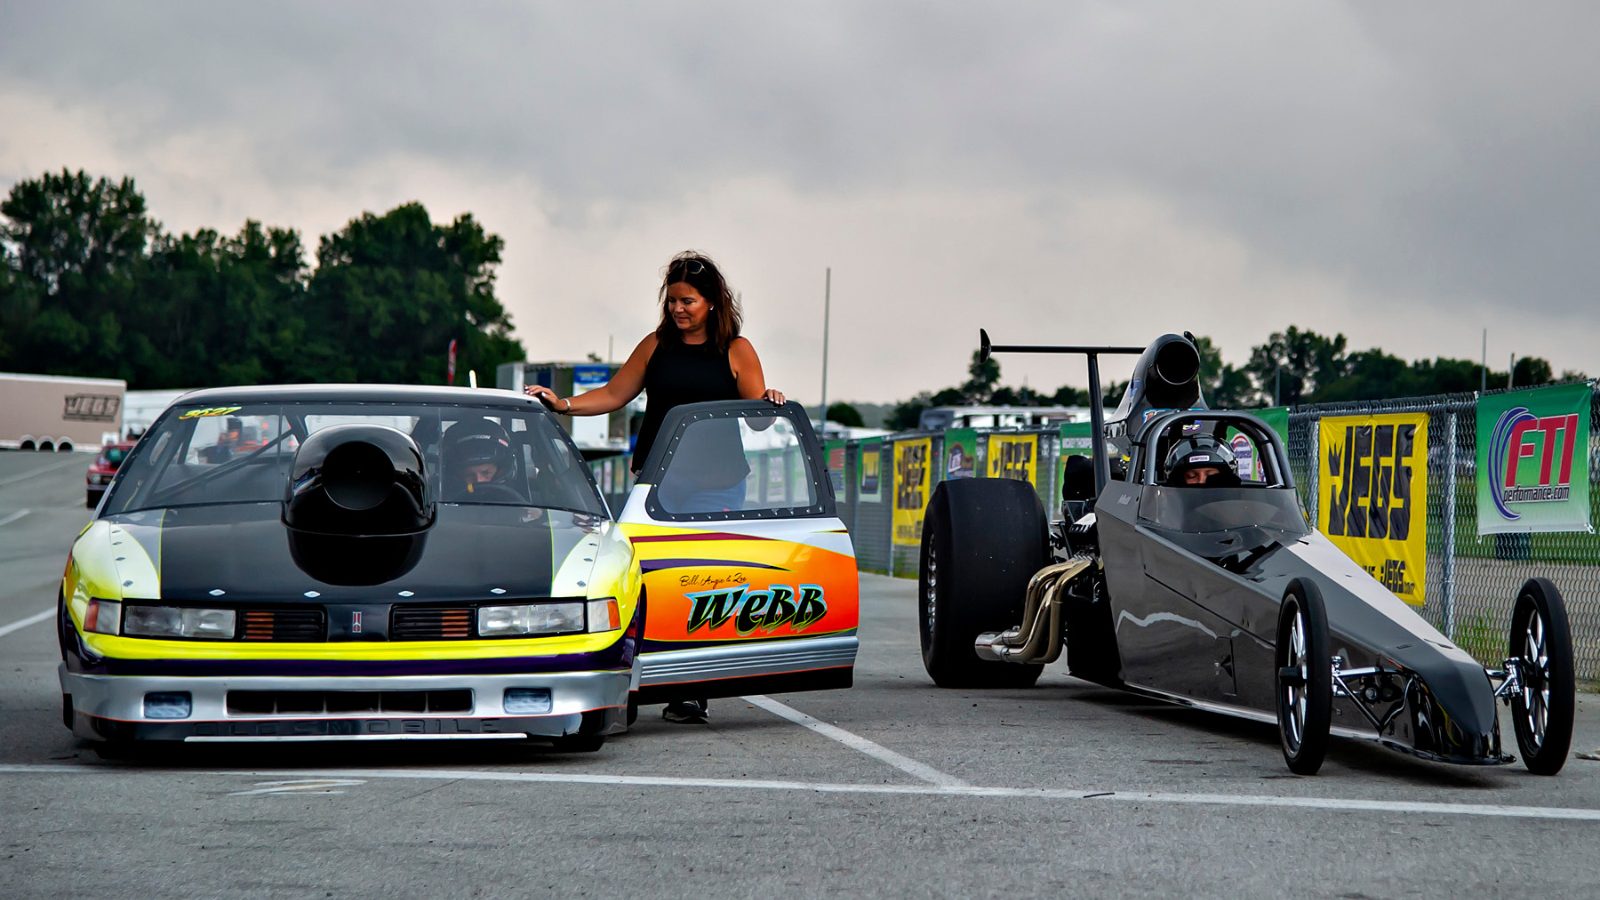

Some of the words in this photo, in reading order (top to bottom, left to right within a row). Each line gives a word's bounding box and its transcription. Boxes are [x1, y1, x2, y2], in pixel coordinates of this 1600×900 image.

[64, 393, 120, 422] JEGS
[1504, 413, 1579, 489] FTI
[1327, 423, 1417, 542] JEGS
[1503, 485, 1570, 503] performance.com
